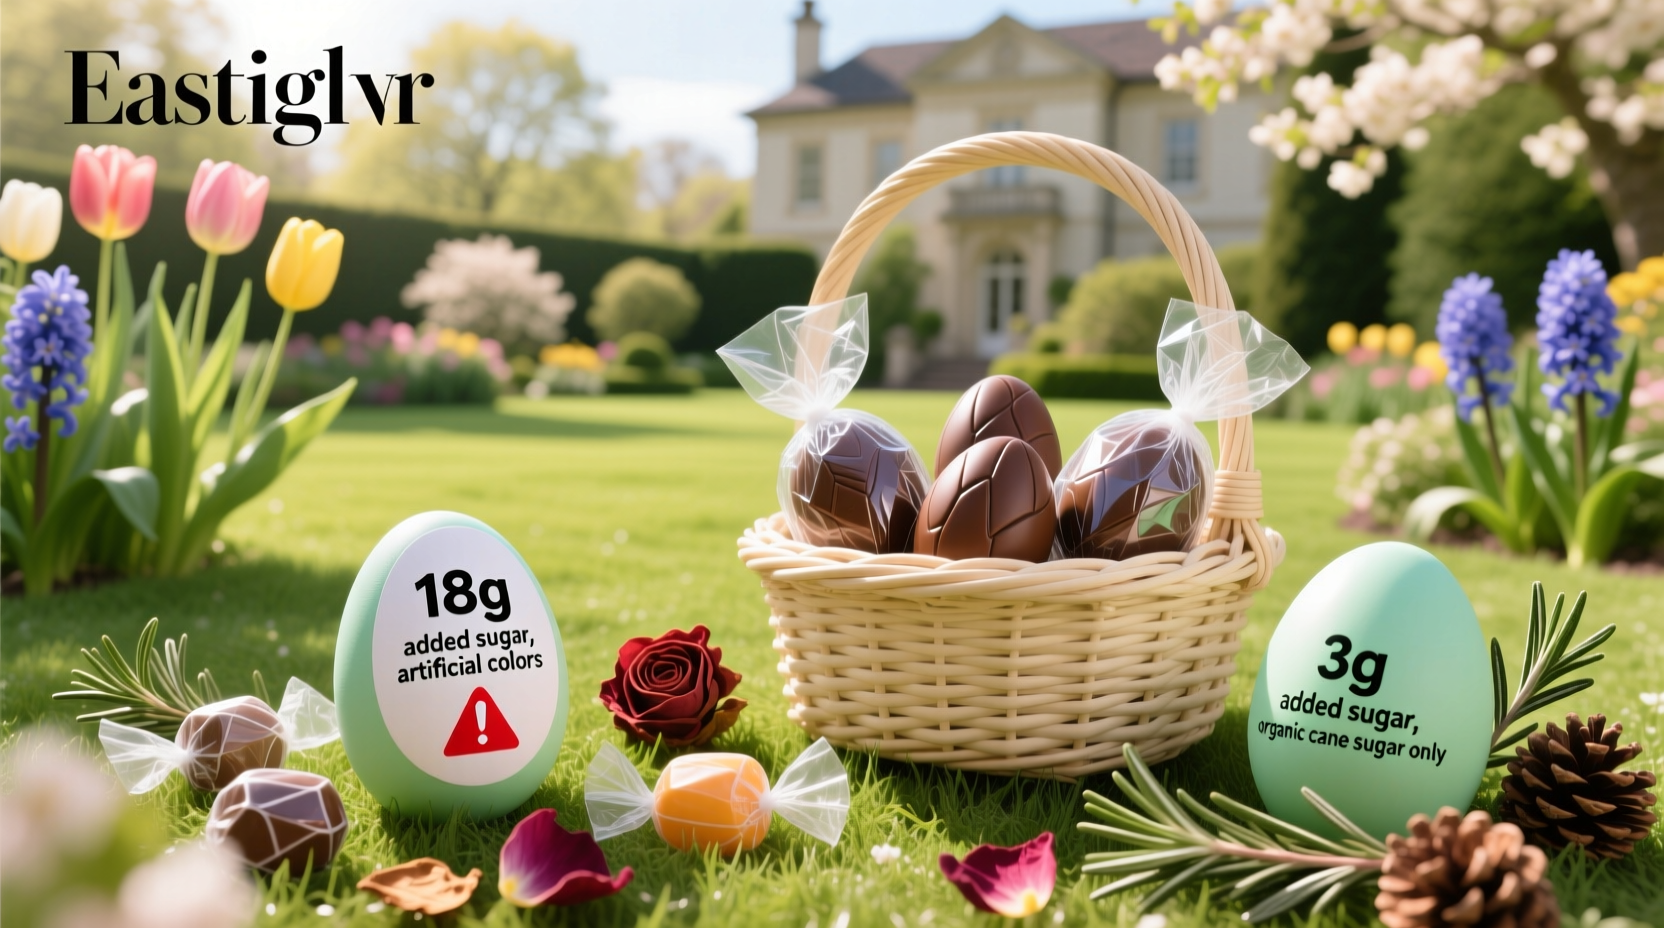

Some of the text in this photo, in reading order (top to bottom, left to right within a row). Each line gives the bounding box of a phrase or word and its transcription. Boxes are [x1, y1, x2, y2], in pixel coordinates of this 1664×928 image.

[414, 569, 512, 622] 18g
[403, 629, 535, 656] added sugar,
[1317, 634, 1388, 697] 3g
[397, 650, 543, 683] artificial colors
[1280, 690, 1419, 735] added sugar,
[1258, 720, 1447, 767] organic cane sugar only
